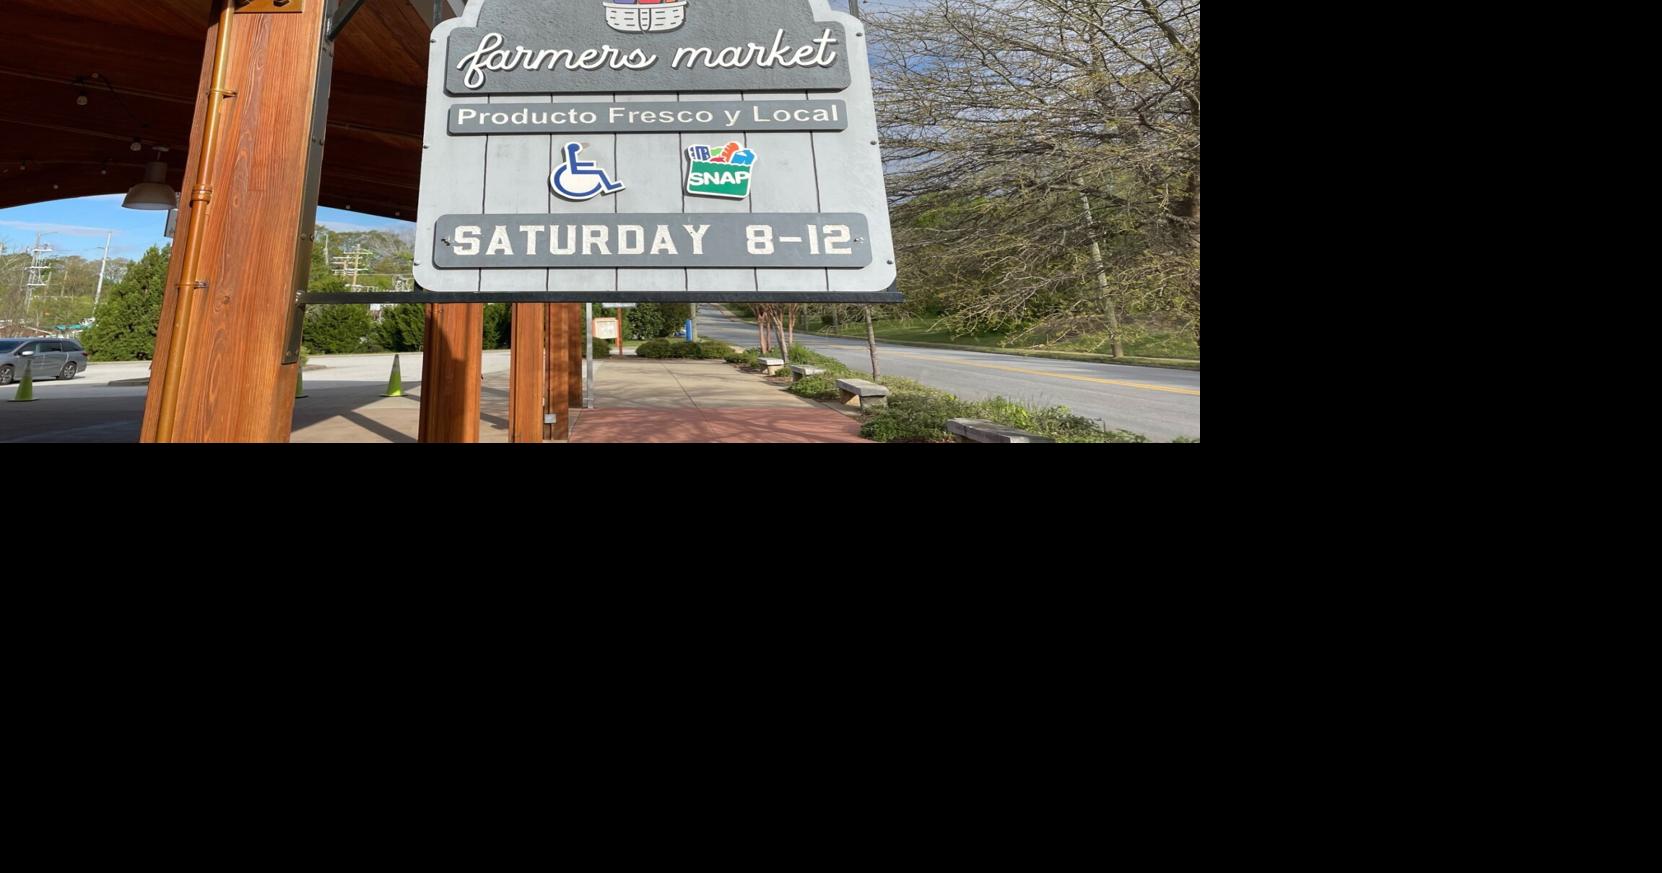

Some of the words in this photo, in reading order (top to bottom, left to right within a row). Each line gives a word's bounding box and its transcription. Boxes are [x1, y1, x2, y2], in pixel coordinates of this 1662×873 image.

[457, 32, 657, 89] farmers
[672, 28, 837, 69] market
[457, 108, 597, 127] Producto
[609, 106, 714, 125] Fresco
[724, 109, 739, 127] y
[753, 104, 839, 124] Local
[689, 171, 750, 186] SNAP
[453, 223, 711, 257] SATURDAY
[746, 223, 853, 256] 8-12
